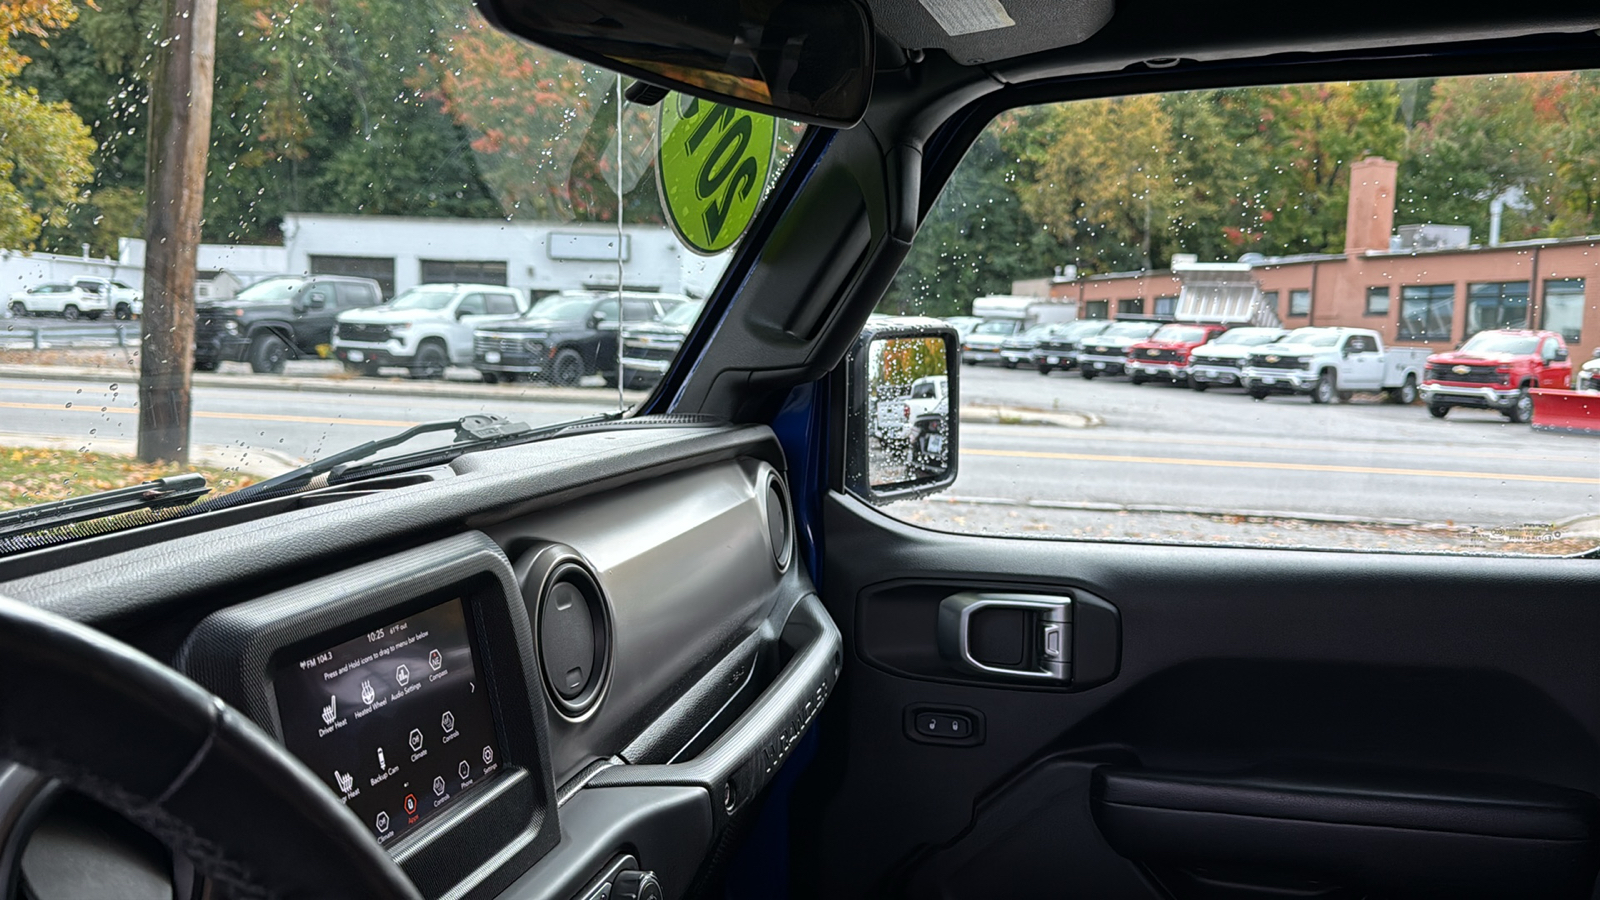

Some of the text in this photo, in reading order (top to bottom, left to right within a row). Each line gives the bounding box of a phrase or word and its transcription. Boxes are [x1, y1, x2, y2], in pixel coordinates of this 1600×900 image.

[400, 622, 408, 631] out
[367, 628, 385, 643] 10:25
[306, 651, 333, 669] FM 104.3
[323, 630, 429, 681] Press and Hold icons to drag to menu bar below
[429, 669, 449, 682] Compass
[391, 682, 422, 701] Audio Settings
[354, 696, 388, 719] Heated Wheel
[318, 718, 348, 738] Driver Heat
[442, 729, 460, 744] Controls
[410, 749, 428, 762] Climate
[370, 765, 400, 787] Backup Cam
[483, 763, 498, 775] Settings
[460, 779, 473, 790] Phone
[347, 787, 360, 799] Heat
[433, 793, 450, 808] Controls
[408, 814, 419, 825] Apps
[377, 830, 395, 845] Climate
